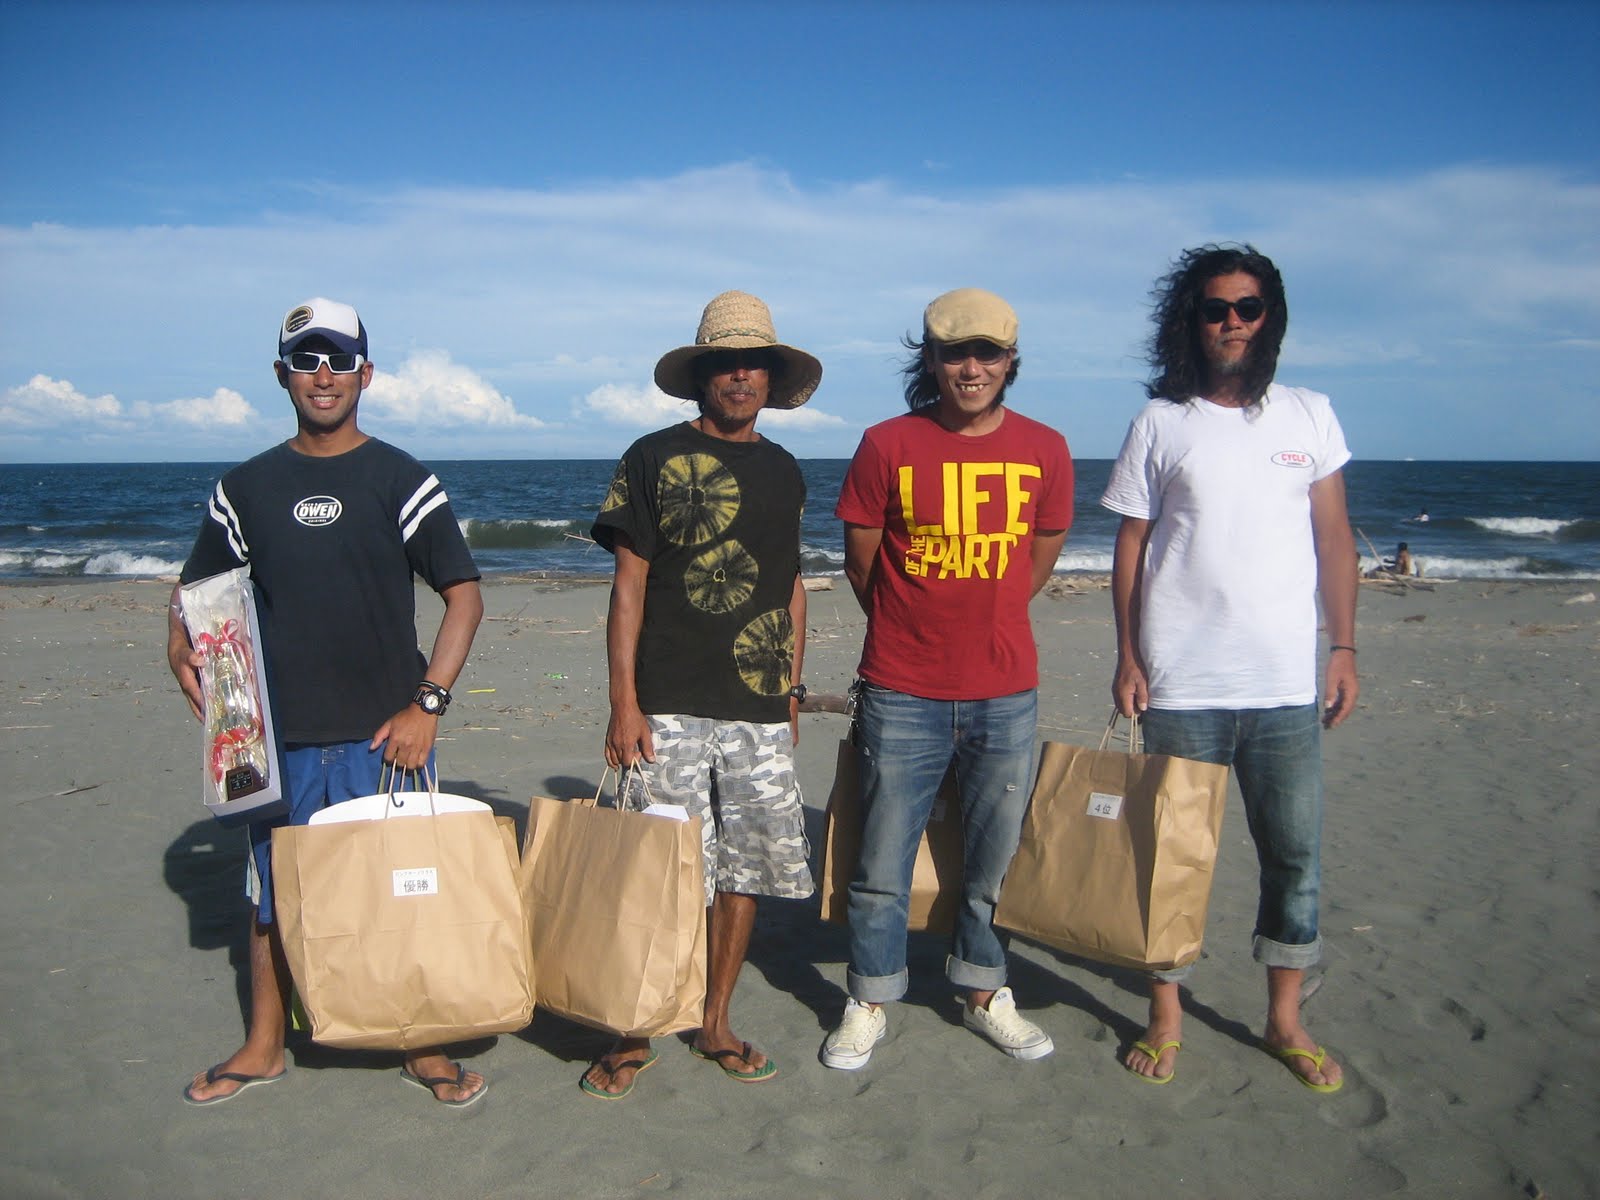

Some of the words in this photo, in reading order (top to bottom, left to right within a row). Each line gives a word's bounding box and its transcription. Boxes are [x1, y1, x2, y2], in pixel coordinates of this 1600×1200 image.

[1281, 453, 1306, 463] CYCLE
[898, 462, 1041, 536] LIFE
[299, 503, 338, 518] OWEN
[920, 533, 1018, 580] PART
[905, 557, 920, 576] OF
[403, 879, 429, 893] 優勝
